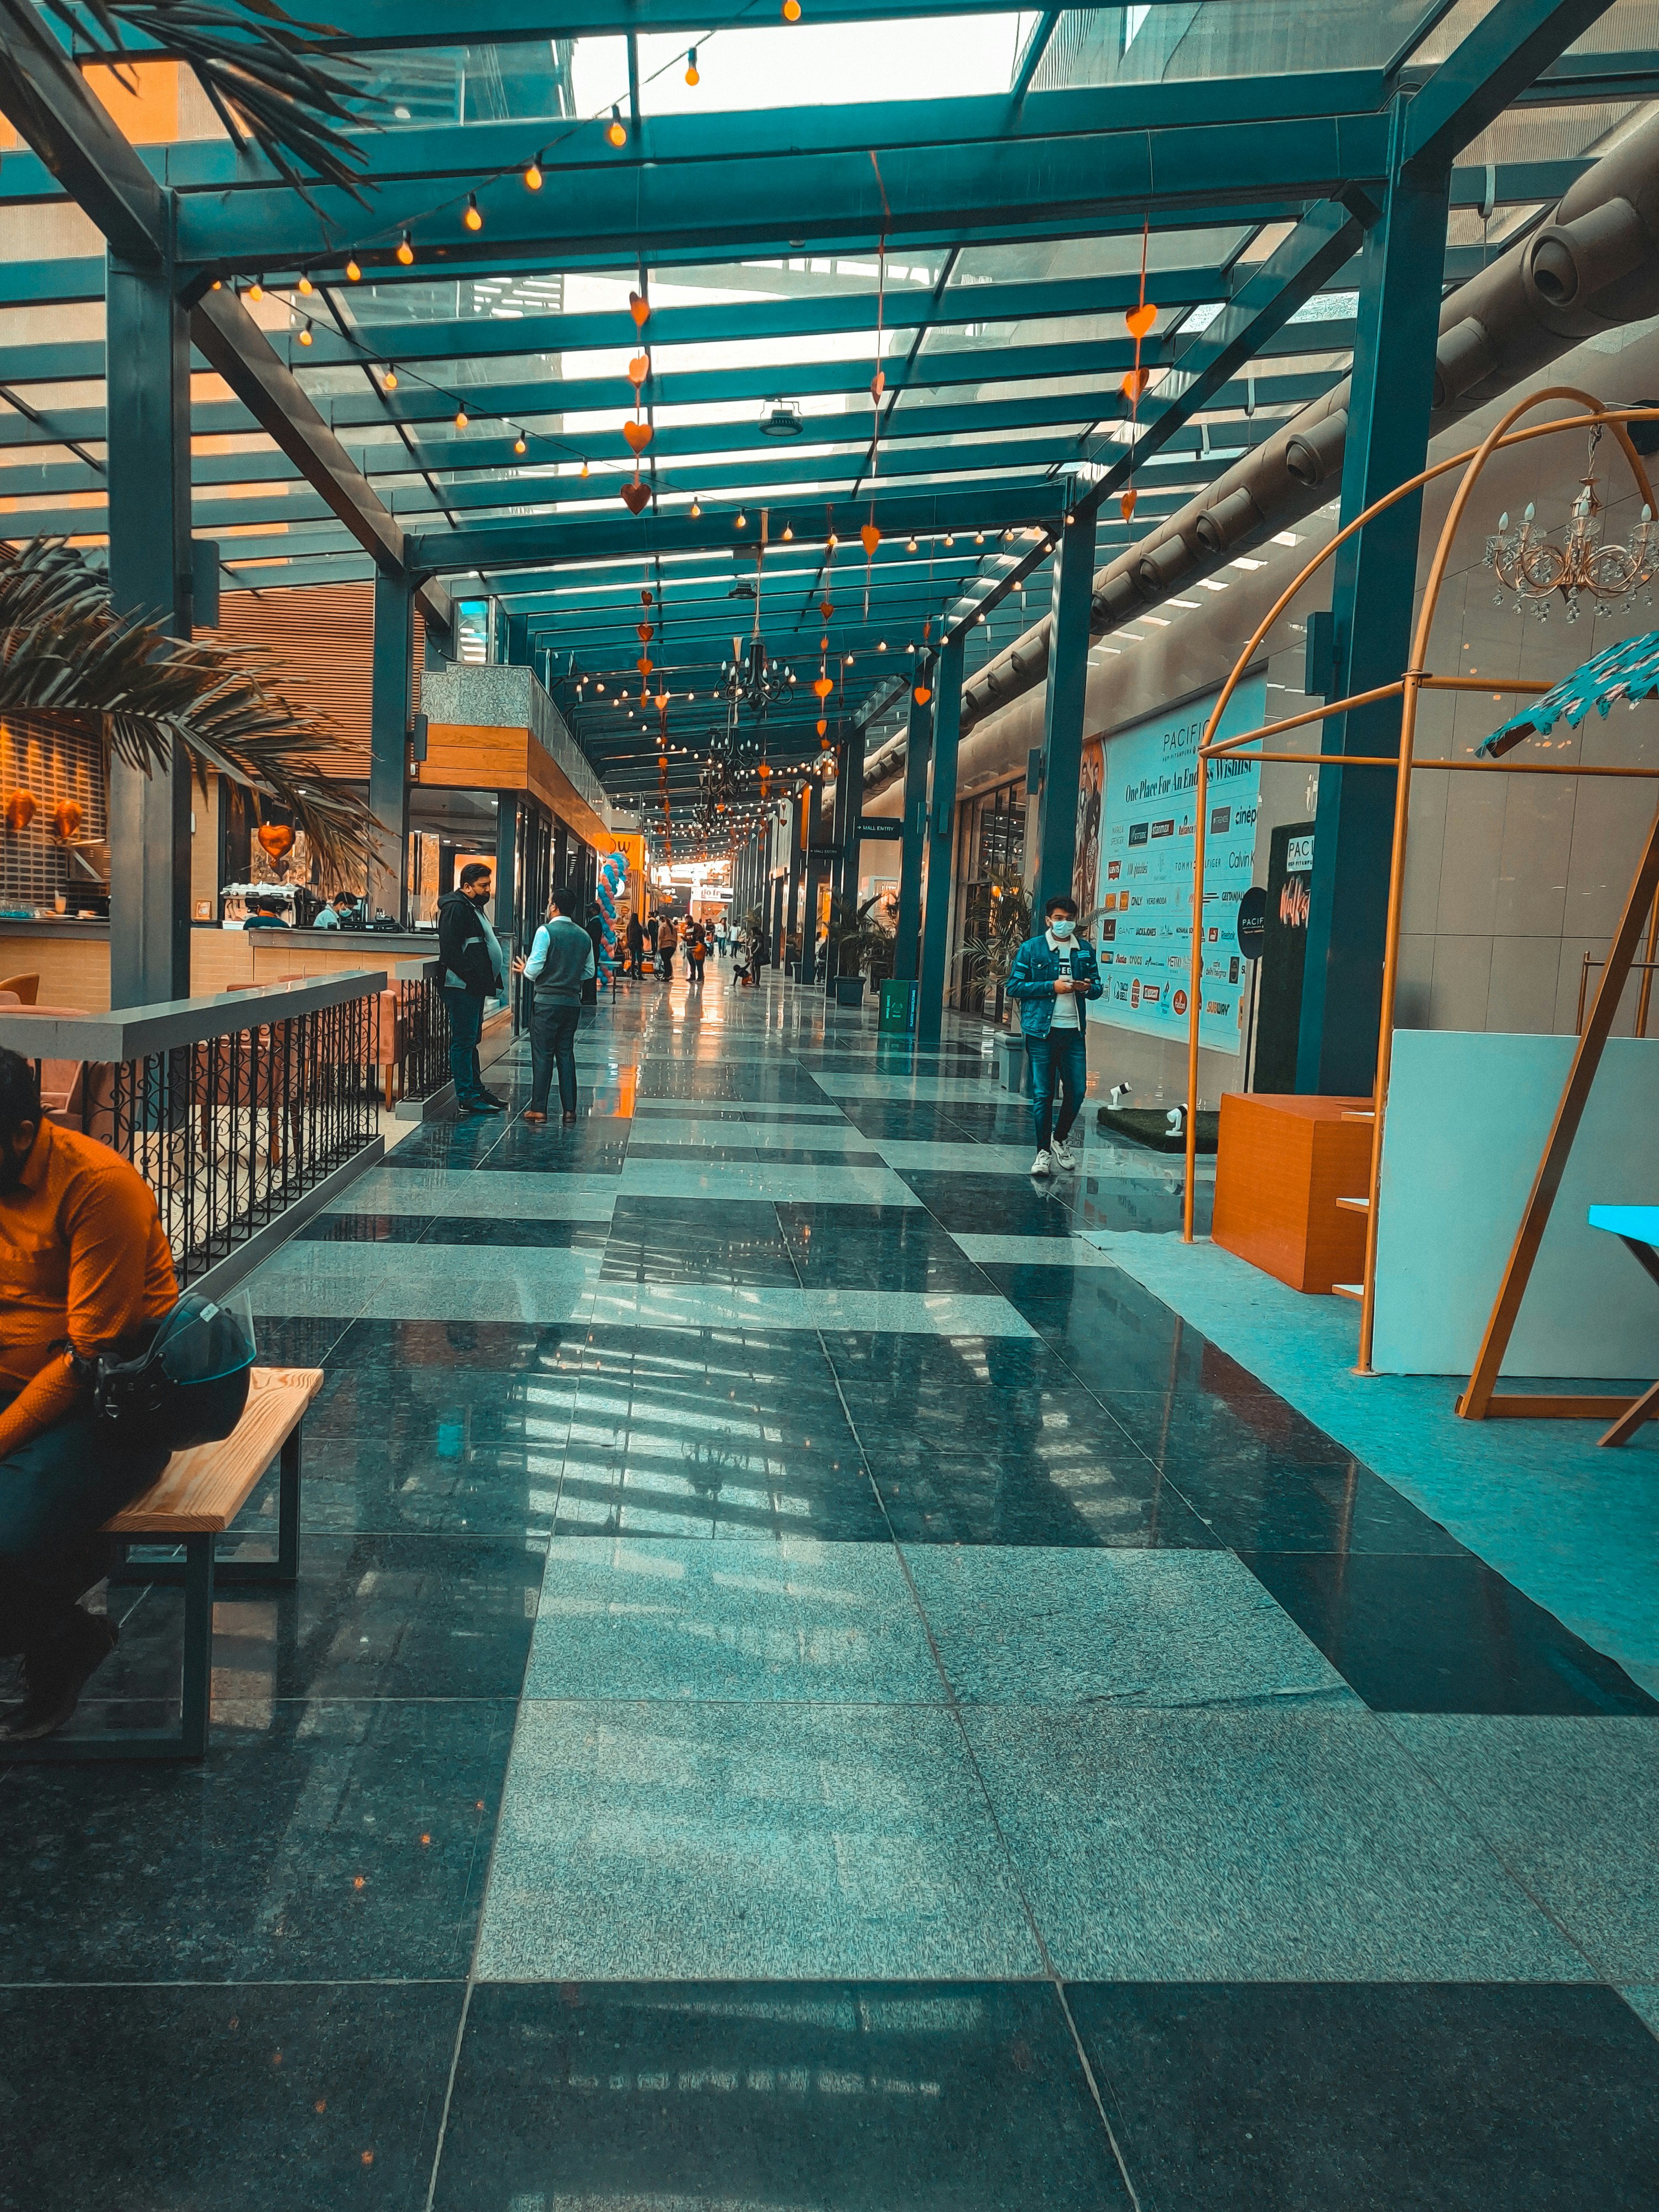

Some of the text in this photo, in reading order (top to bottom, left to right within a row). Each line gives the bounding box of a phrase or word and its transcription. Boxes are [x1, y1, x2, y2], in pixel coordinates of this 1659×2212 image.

[1126, 785, 1138, 802] One
[1139, 779, 1157, 799] Place
[1159, 775, 1171, 795] For
[1172, 771, 1182, 791] An
[1289, 840, 1313, 858] PACI
[1175, 861, 1192, 871] TOMMY
[1229, 852, 1249, 869] Calvin
[1131, 896, 1143, 906] ONLY
[1242, 917, 1264, 926] PACIF
[1120, 982, 1128, 992] TACO
[1207, 1001, 1230, 1016] SUBWAY
